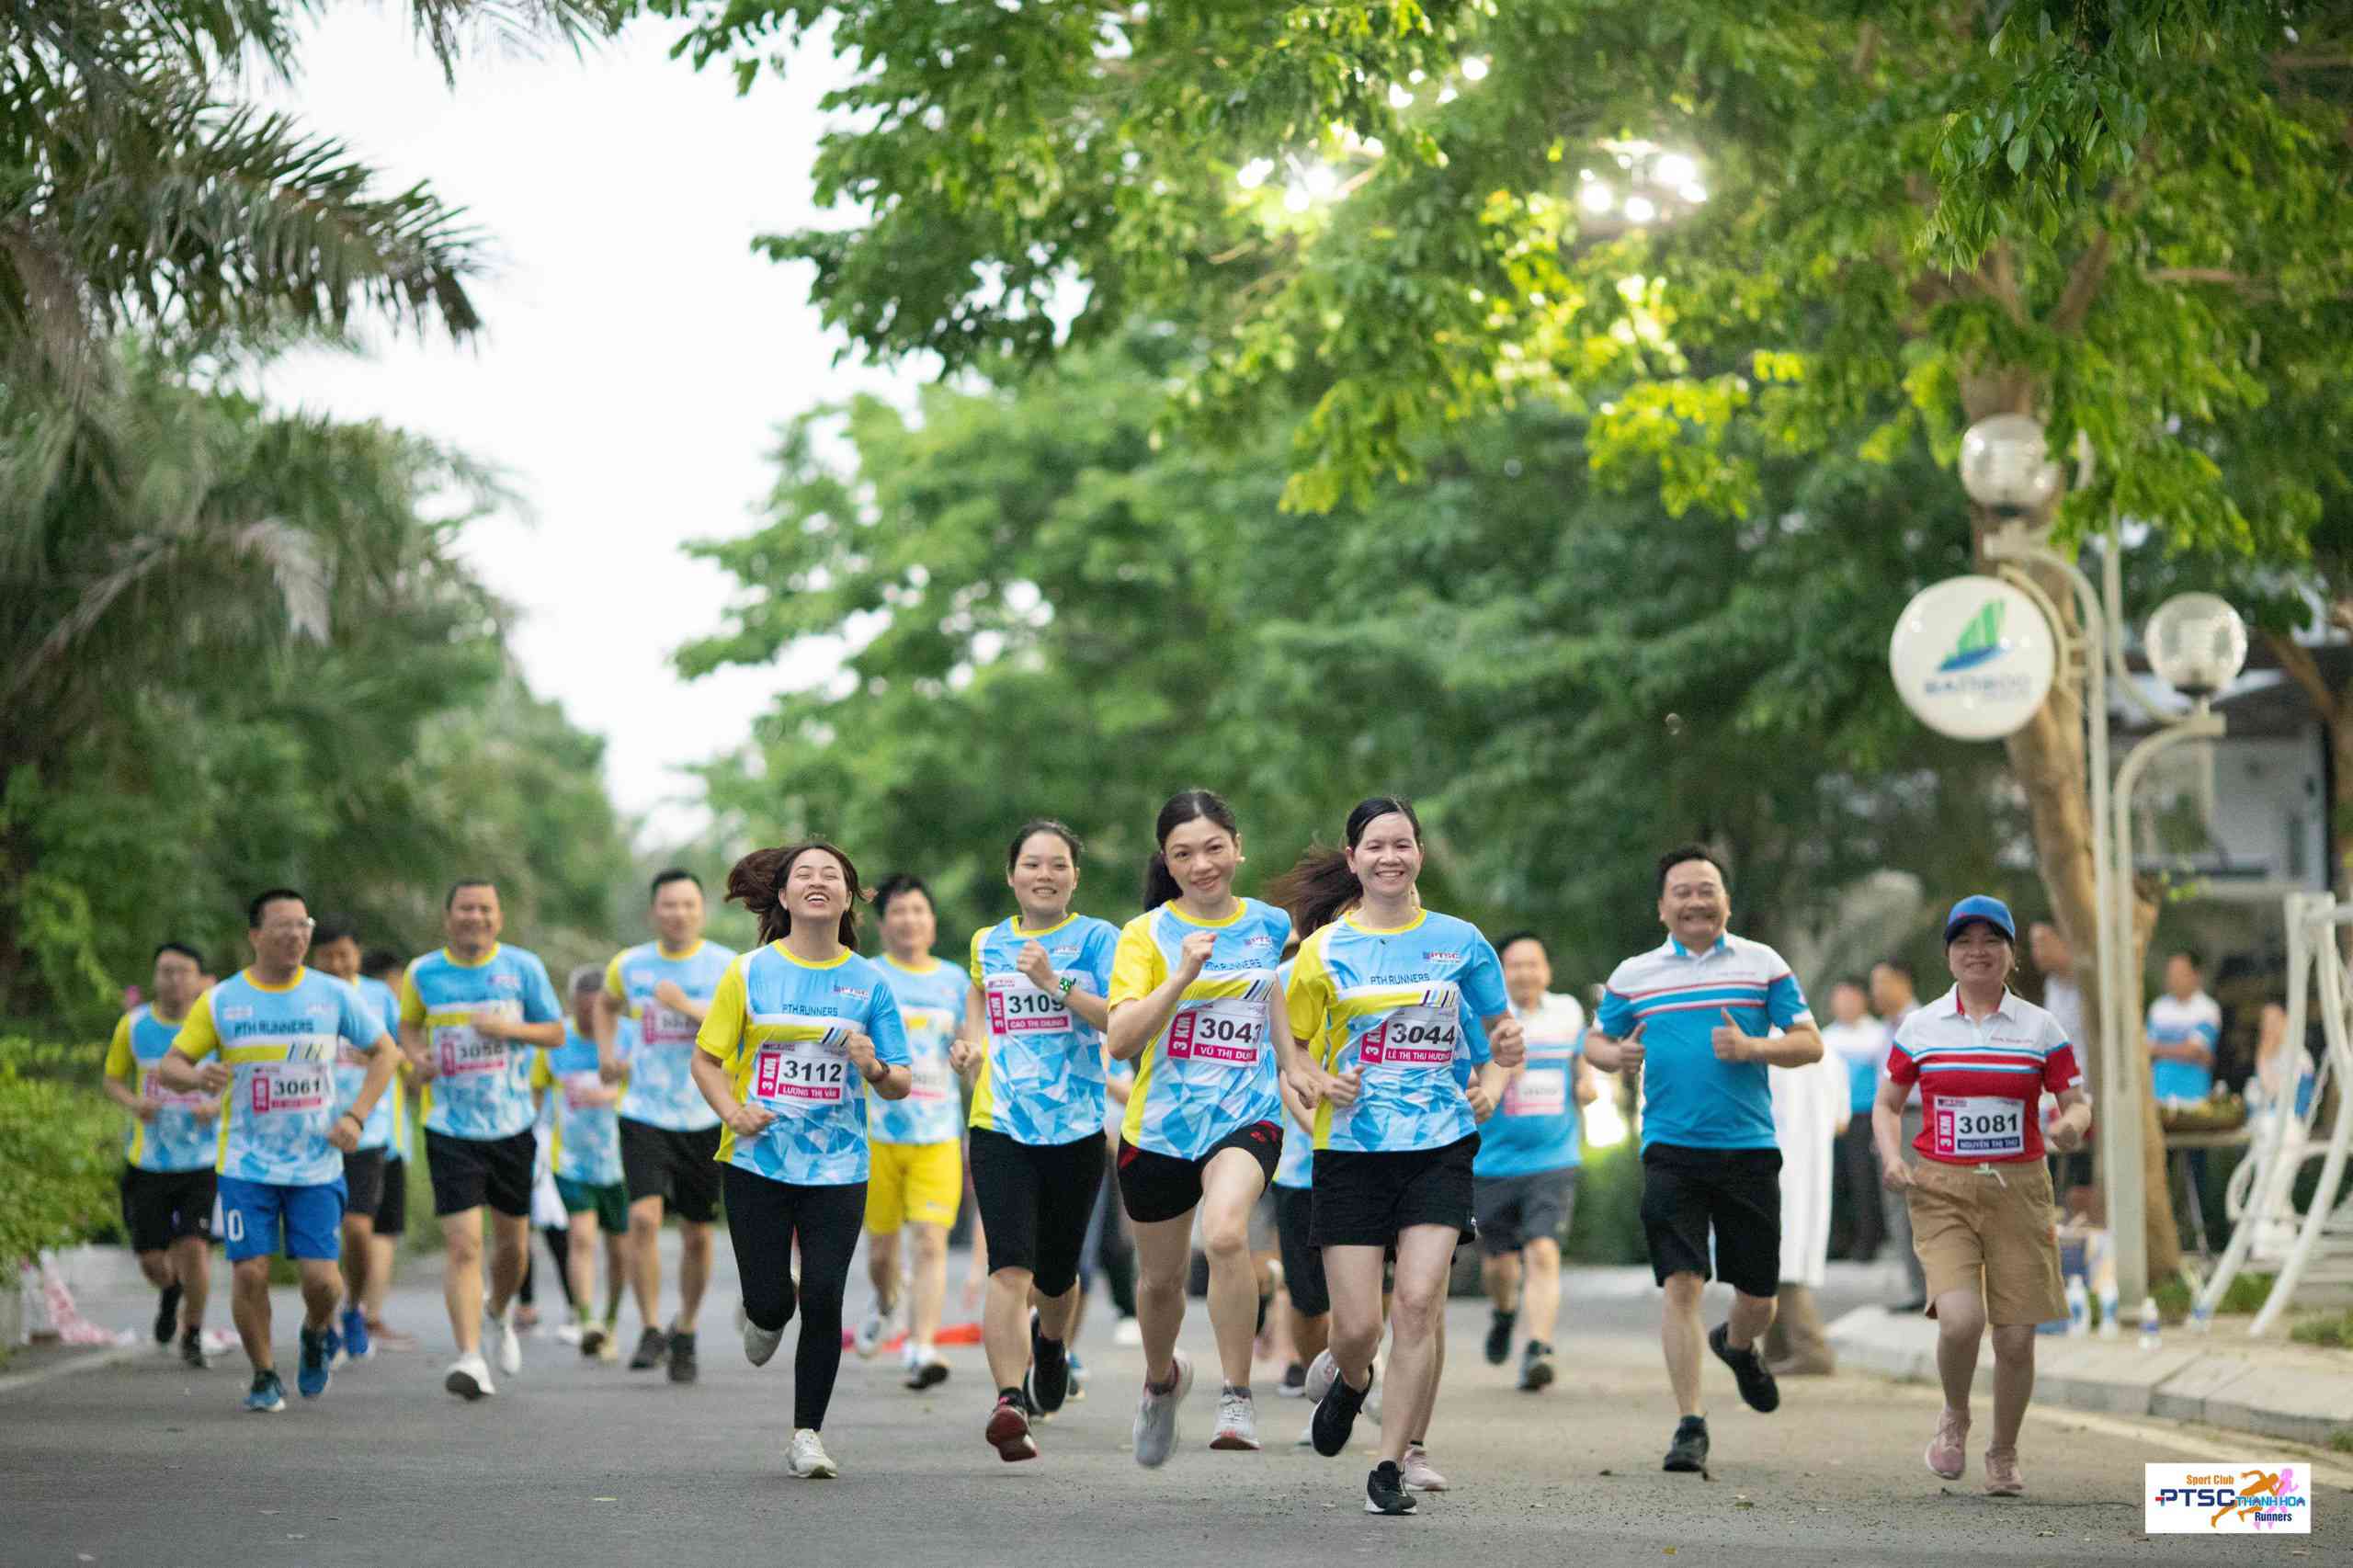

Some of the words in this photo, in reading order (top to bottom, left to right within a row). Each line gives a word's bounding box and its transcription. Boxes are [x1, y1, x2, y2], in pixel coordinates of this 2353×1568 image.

[1370, 975, 1387, 985] PTH
[1389, 973, 1430, 984] RUNNERS
[801, 1005, 838, 1016] RUNNERS
[258, 1019, 314, 1035] RUNNERS
[1391, 1023, 1456, 1045] 3044
[1173, 1040, 1188, 1051] 3
[1365, 1045, 1380, 1056] 3
[1216, 1047, 1233, 1061] THỊ
[1413, 1051, 1427, 1061] THU
[783, 1060, 843, 1083] 3112
[274, 1078, 321, 1096] 3061
[761, 1081, 773, 1091] 3
[1959, 1113, 2018, 1134] 3081
[1939, 1137, 1952, 1148] 3
